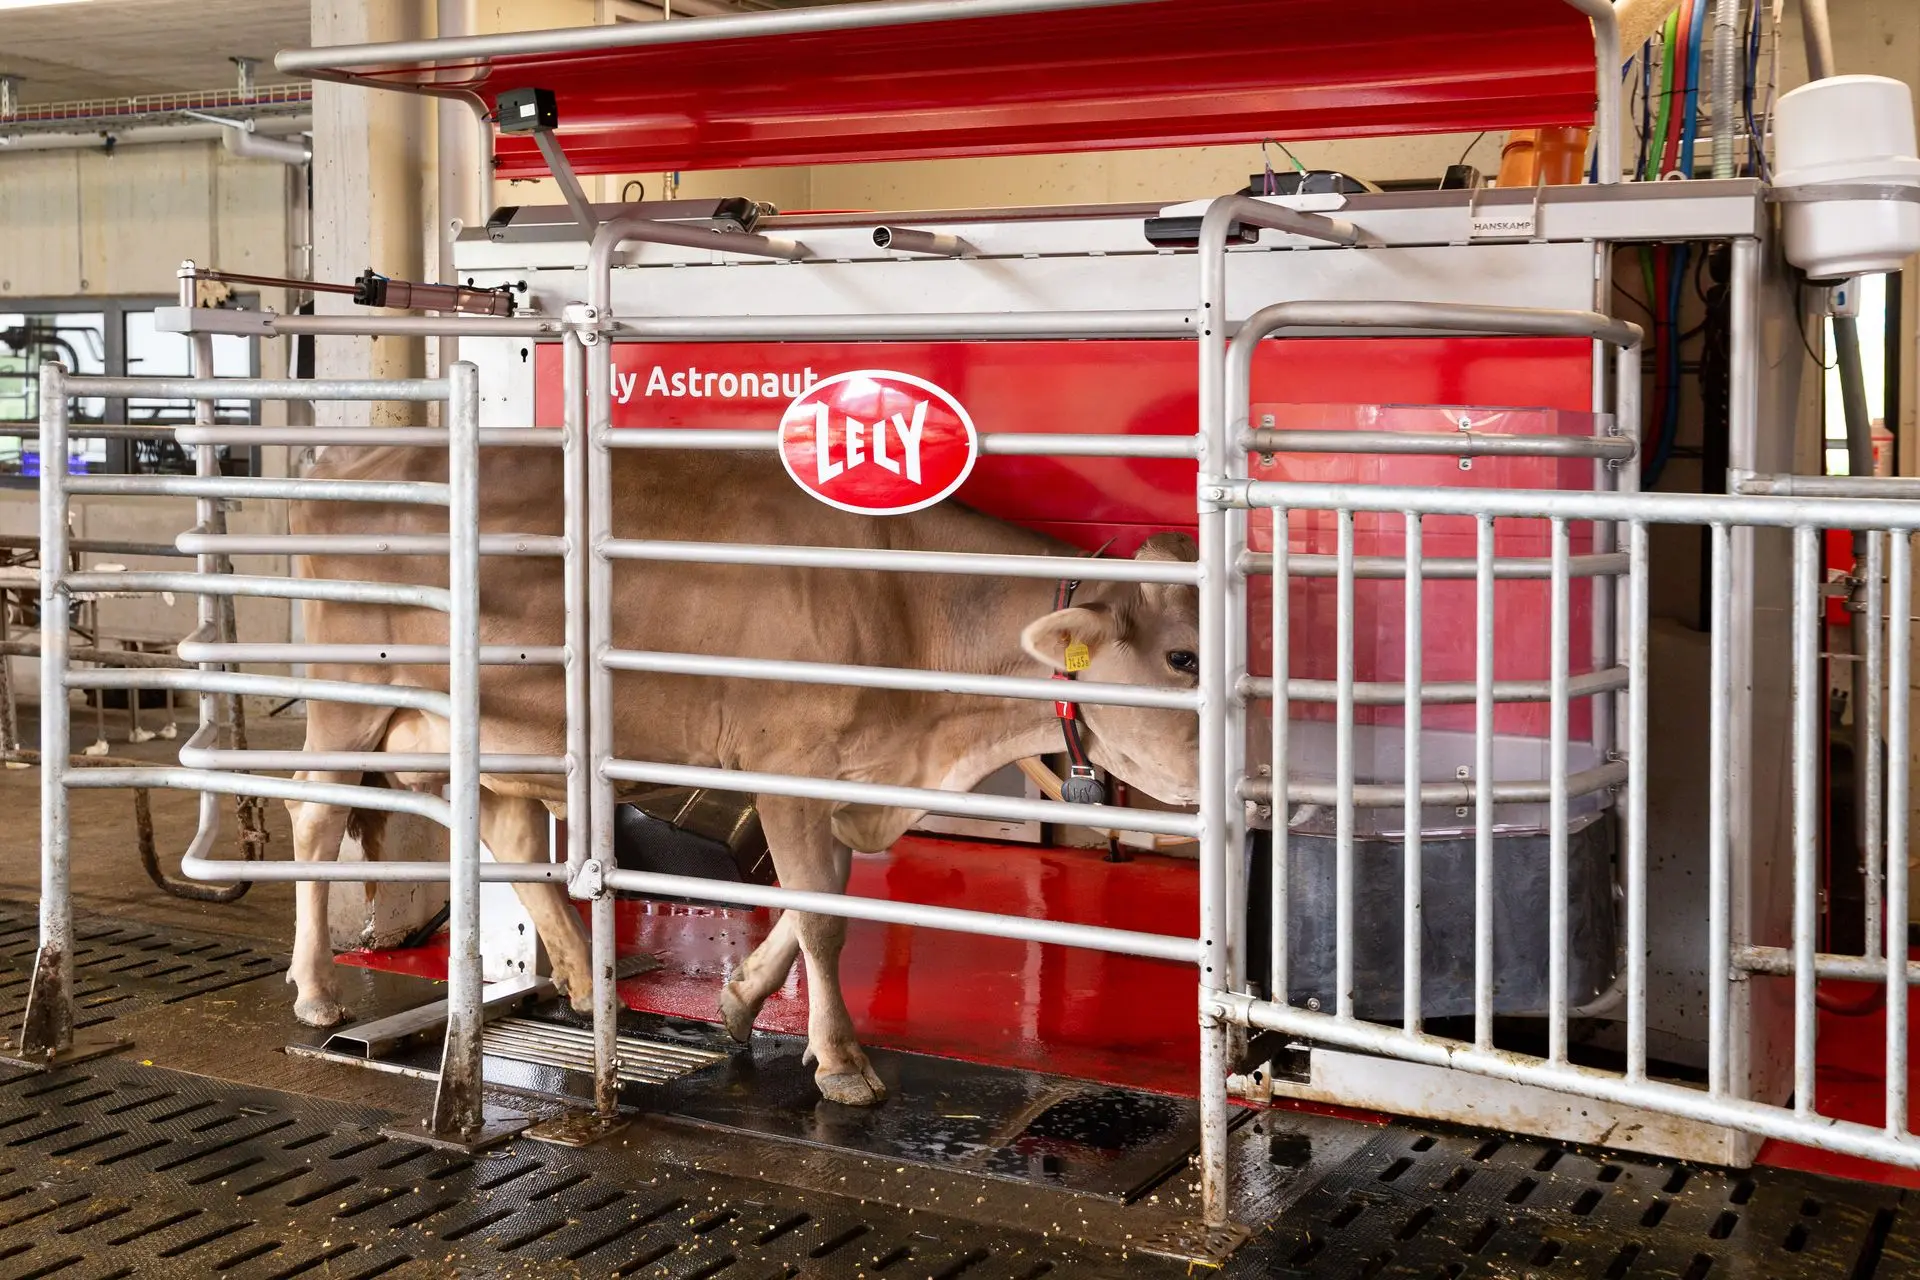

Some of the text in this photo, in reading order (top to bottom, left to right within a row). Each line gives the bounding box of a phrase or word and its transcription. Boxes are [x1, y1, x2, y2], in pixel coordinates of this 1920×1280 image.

[1474, 222, 1531, 231] HANSKAMP
[609, 363, 818, 404] ly Astronaut
[815, 399, 929, 485] LELY
